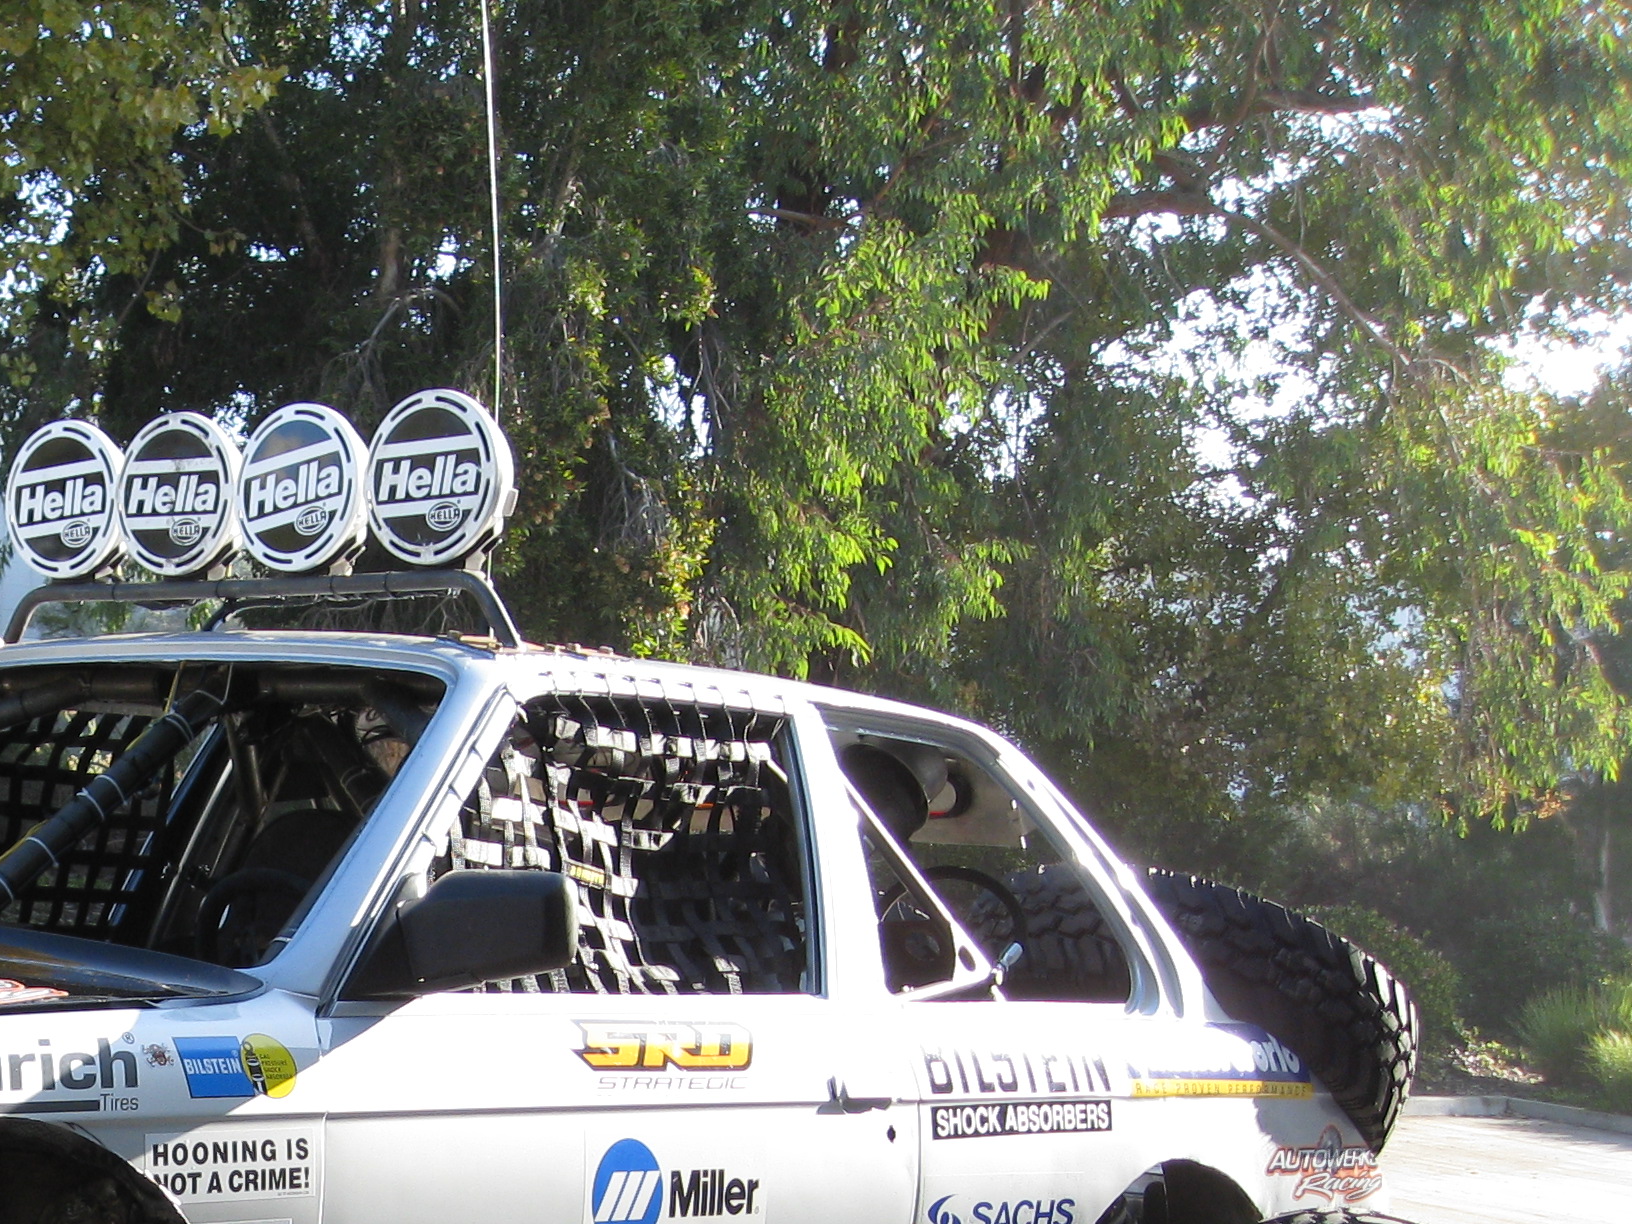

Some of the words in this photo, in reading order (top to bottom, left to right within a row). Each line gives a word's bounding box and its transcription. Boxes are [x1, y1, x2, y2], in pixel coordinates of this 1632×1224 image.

[248, 460, 340, 518] Hella
[378, 454, 478, 502] Hella
[19, 477, 103, 524] Hella
[127, 474, 217, 515] Hella
[298, 510, 327, 527] HELLA
[429, 507, 461, 522] HELLA
[63, 524, 91, 539] HELLA
[171, 524, 200, 537] HELLA
[183, 1057, 243, 1076] BILSTEIN
[597, 1076, 748, 1090] STRATEGIC
[99, 1093, 140, 1112] Tires
[936, 1106, 1002, 1138] SHOCK
[1005, 1103, 1110, 1132] ABSORBERS
[152, 1139, 277, 1167] HOONING
[286, 1138, 309, 1160] IS
[207, 1171, 223, 1194] A
[228, 1167, 310, 1193] CRIME!
[668, 1169, 759, 1218] Miller
[1293, 1170, 1382, 1200] Racing
